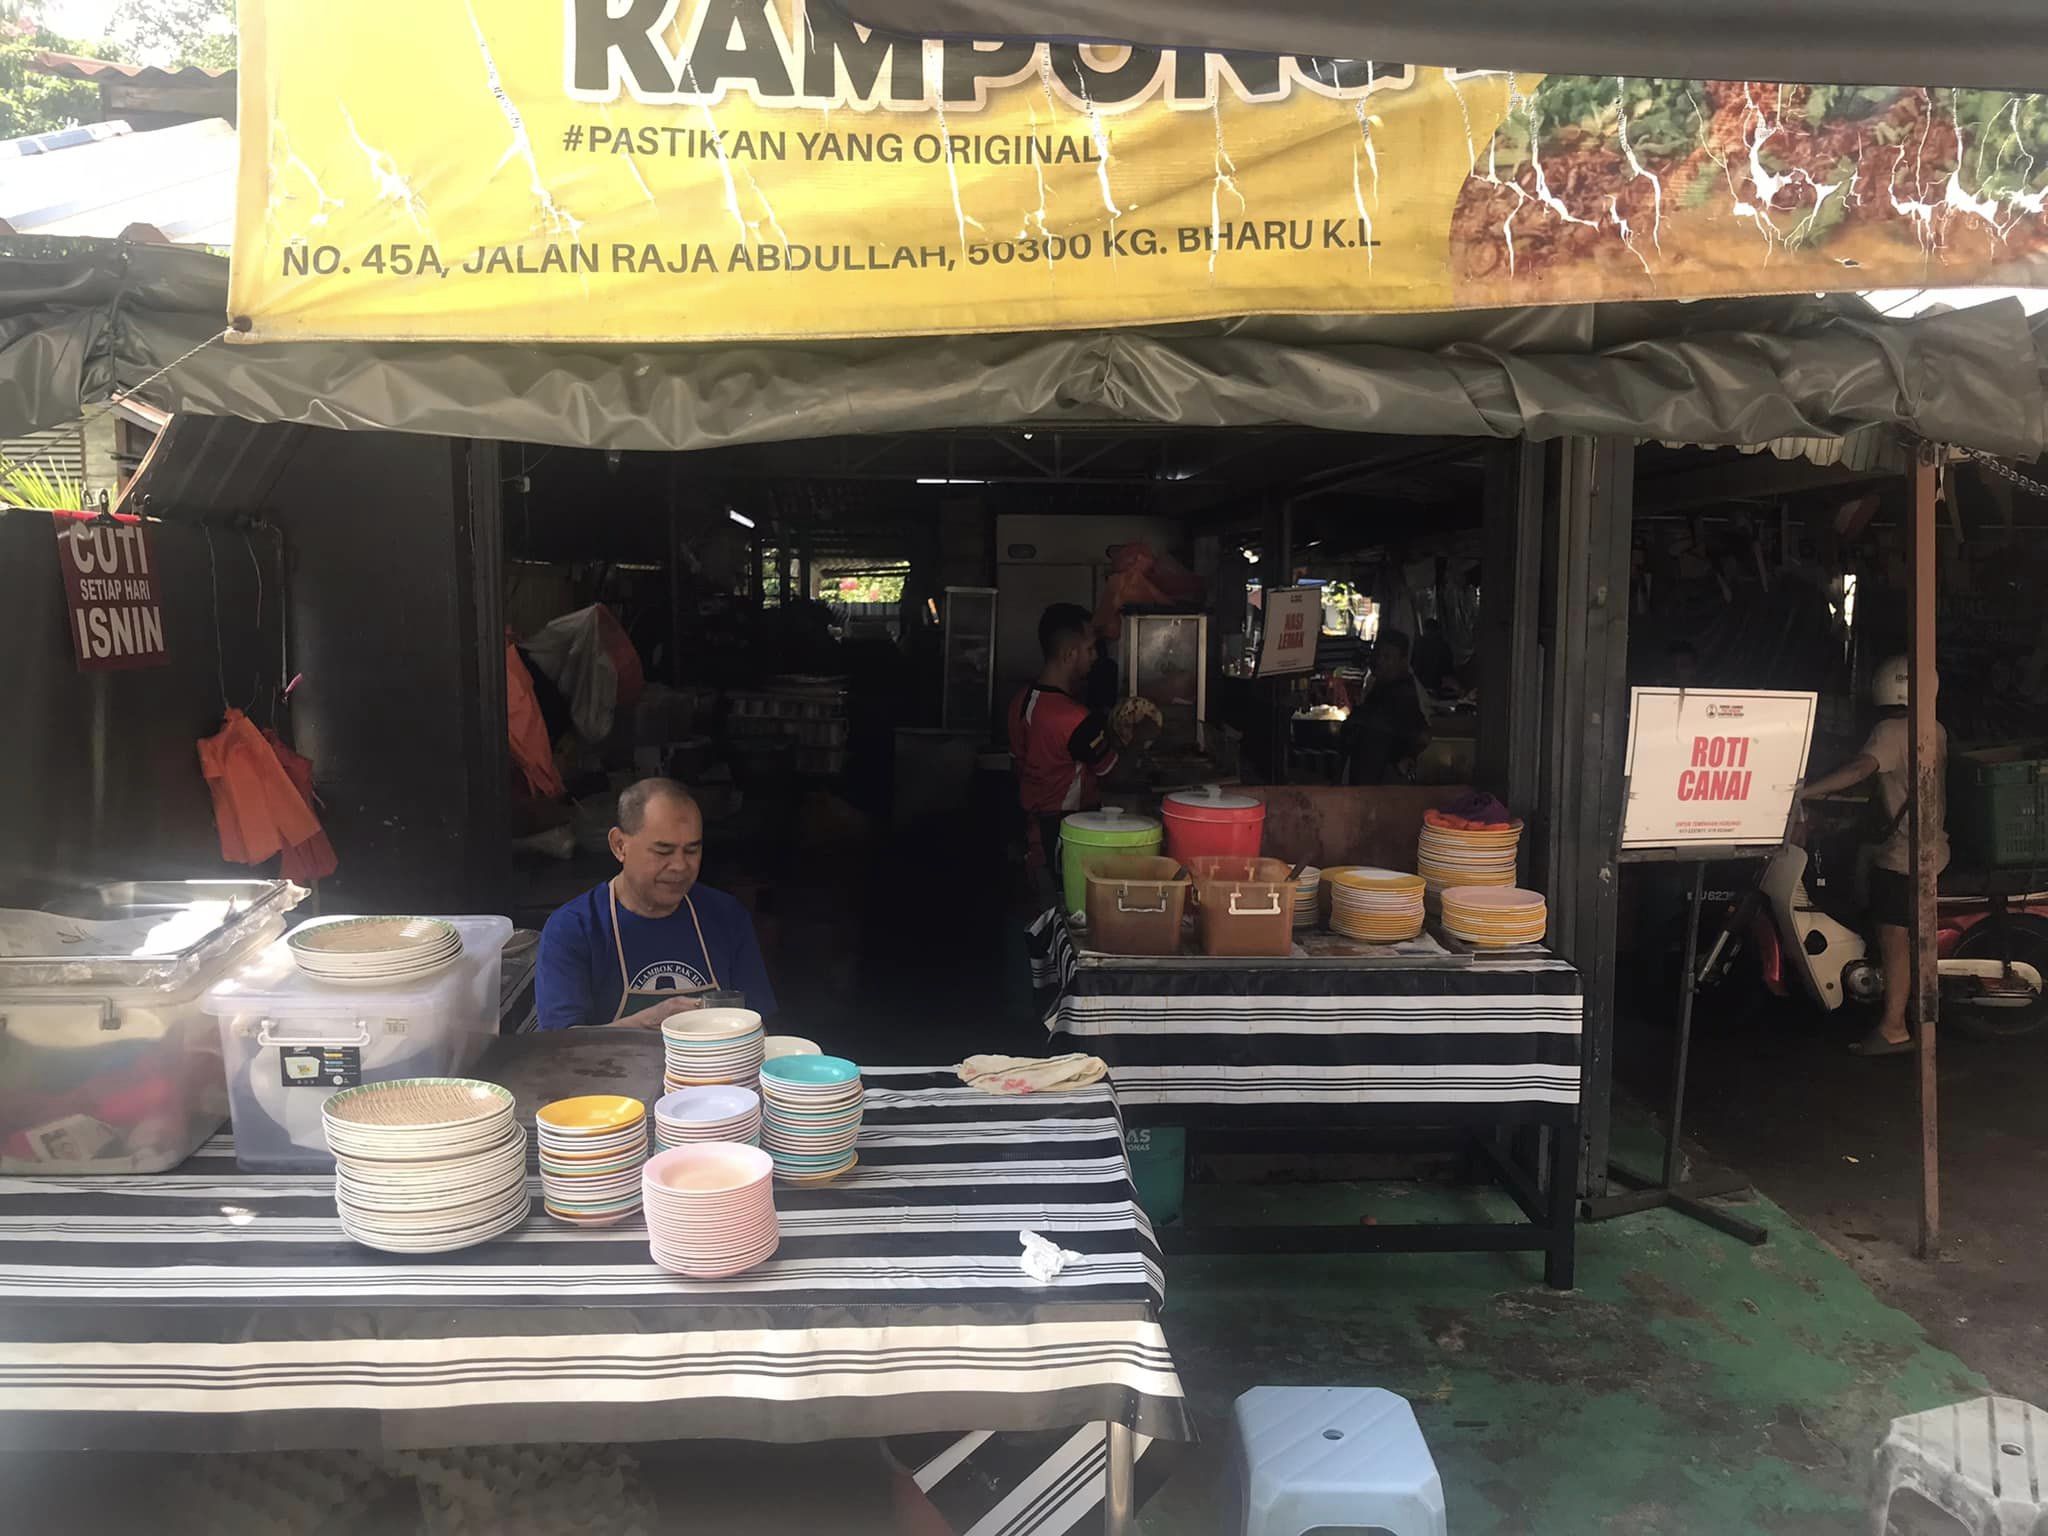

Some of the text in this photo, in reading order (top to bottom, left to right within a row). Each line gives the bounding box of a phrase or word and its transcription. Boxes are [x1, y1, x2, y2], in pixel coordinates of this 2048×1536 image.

[563, 124, 1103, 165] #PASTIKAN YANG ORIGINAL
[281, 245, 351, 276] NO.
[361, 243, 449, 278] 45A,
[462, 245, 598, 275] JALAN
[612, 243, 719, 273] RAJA
[727, 243, 956, 272] ABDULLAH,
[968, 233, 1092, 265] 50300
[1103, 228, 1168, 257] KG.
[1323, 218, 1381, 248] K.L
[70, 521, 148, 574] CUTI
[80, 578, 150, 600] SETIAP HARI
[76, 606, 164, 659] ISNIN
[1691, 736, 1749, 768] ROTI
[1677, 769, 1752, 801] CANAI
